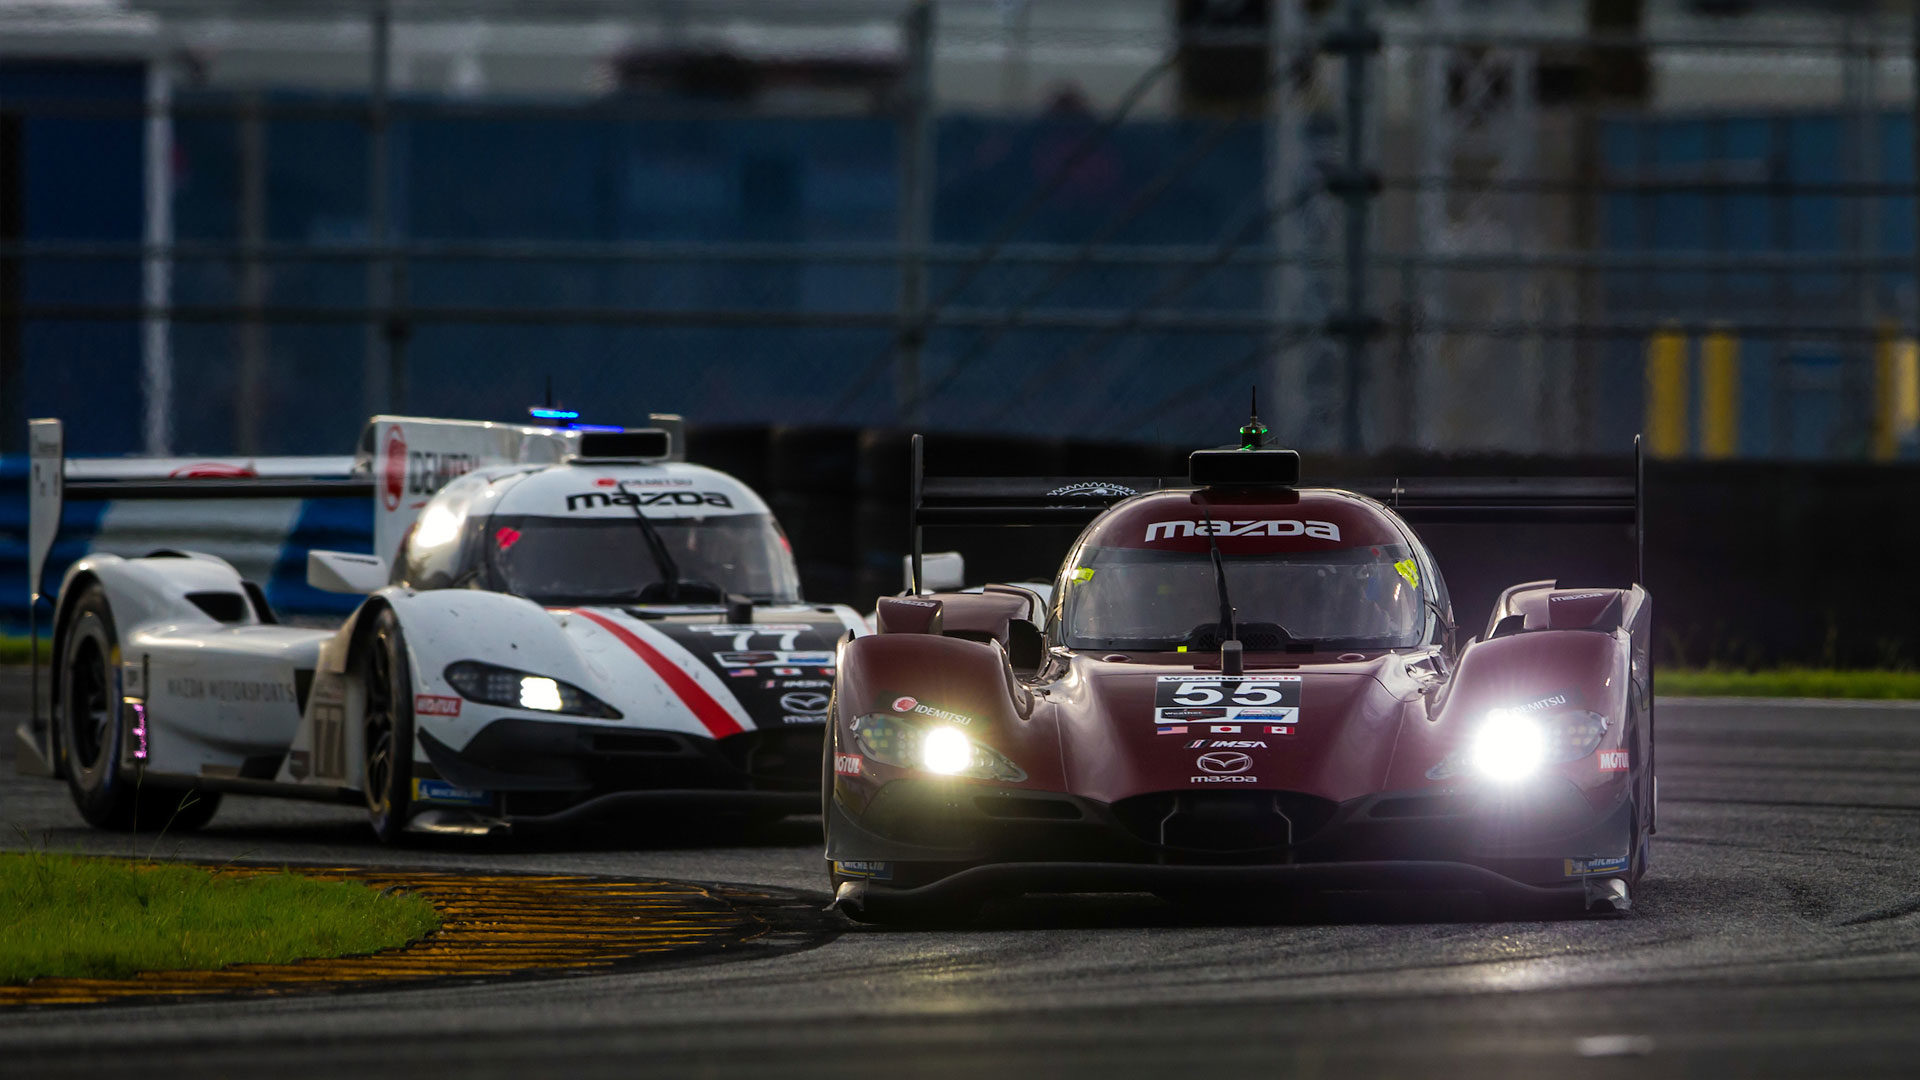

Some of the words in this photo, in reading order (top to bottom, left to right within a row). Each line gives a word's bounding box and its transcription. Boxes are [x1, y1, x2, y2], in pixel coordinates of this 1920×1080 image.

[1145, 520, 1341, 542] mazda
[711, 630, 799, 651] 77
[1172, 682, 1283, 706] 55
[915, 704, 971, 725] IDEMITSU
[1210, 741, 1267, 749] IMSA
[1600, 752, 1629, 769] MOTU
